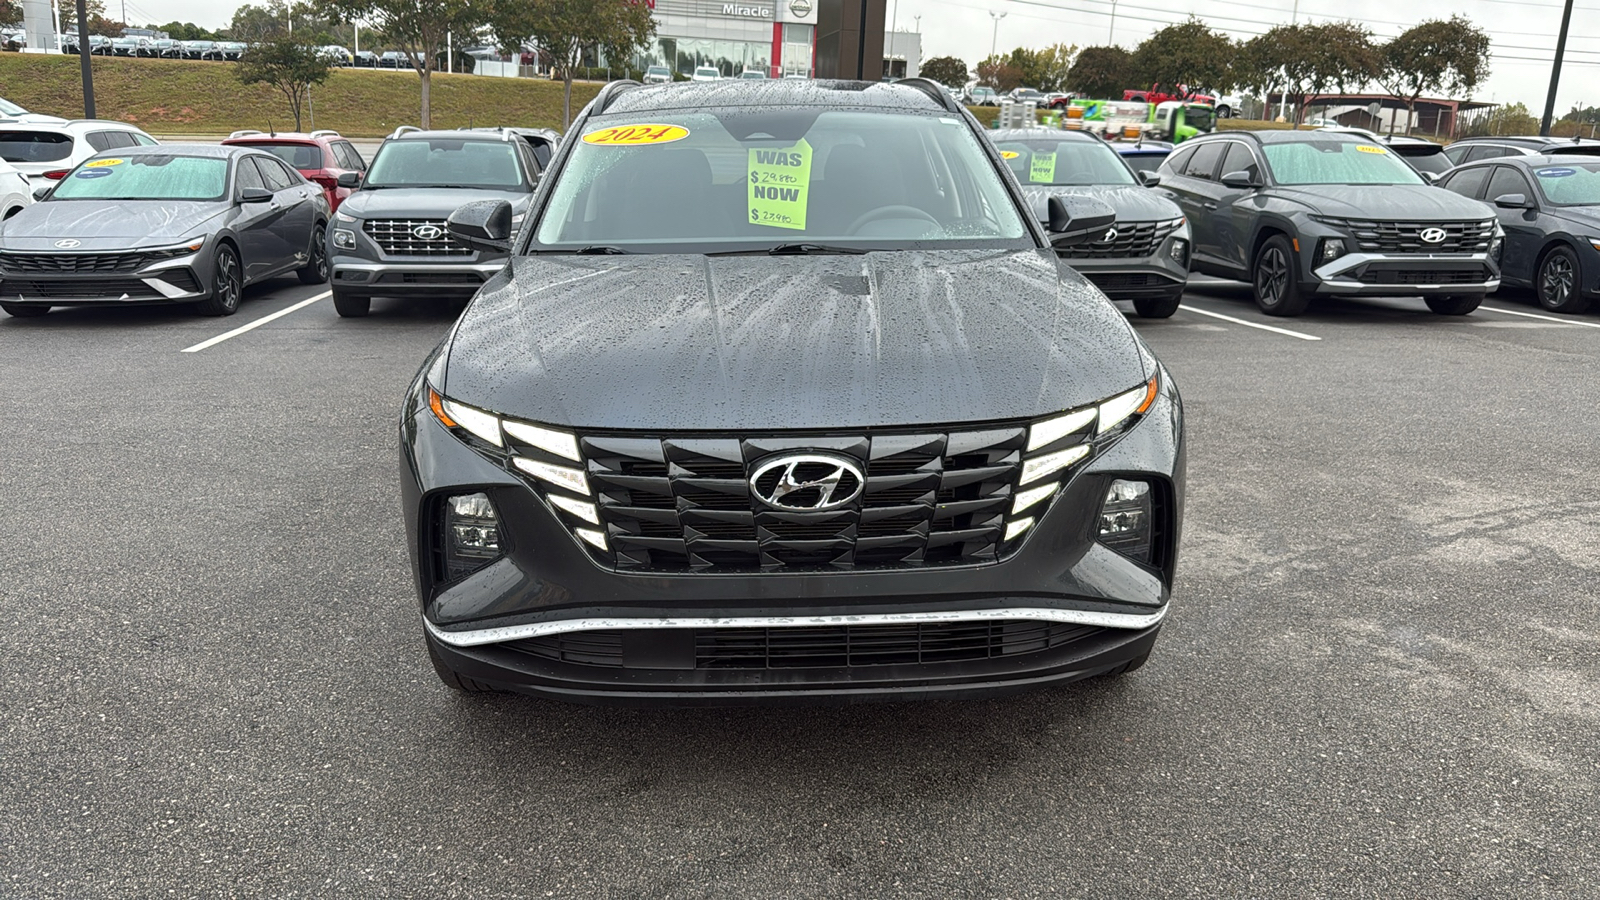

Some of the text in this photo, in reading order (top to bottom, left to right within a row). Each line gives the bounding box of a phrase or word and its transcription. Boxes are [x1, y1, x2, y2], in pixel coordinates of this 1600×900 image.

[722, 4, 769, 17] Miracle
[593, 127, 671, 142] 2024
[756, 150, 802, 167] WAS
[754, 185, 800, 202] NOW
